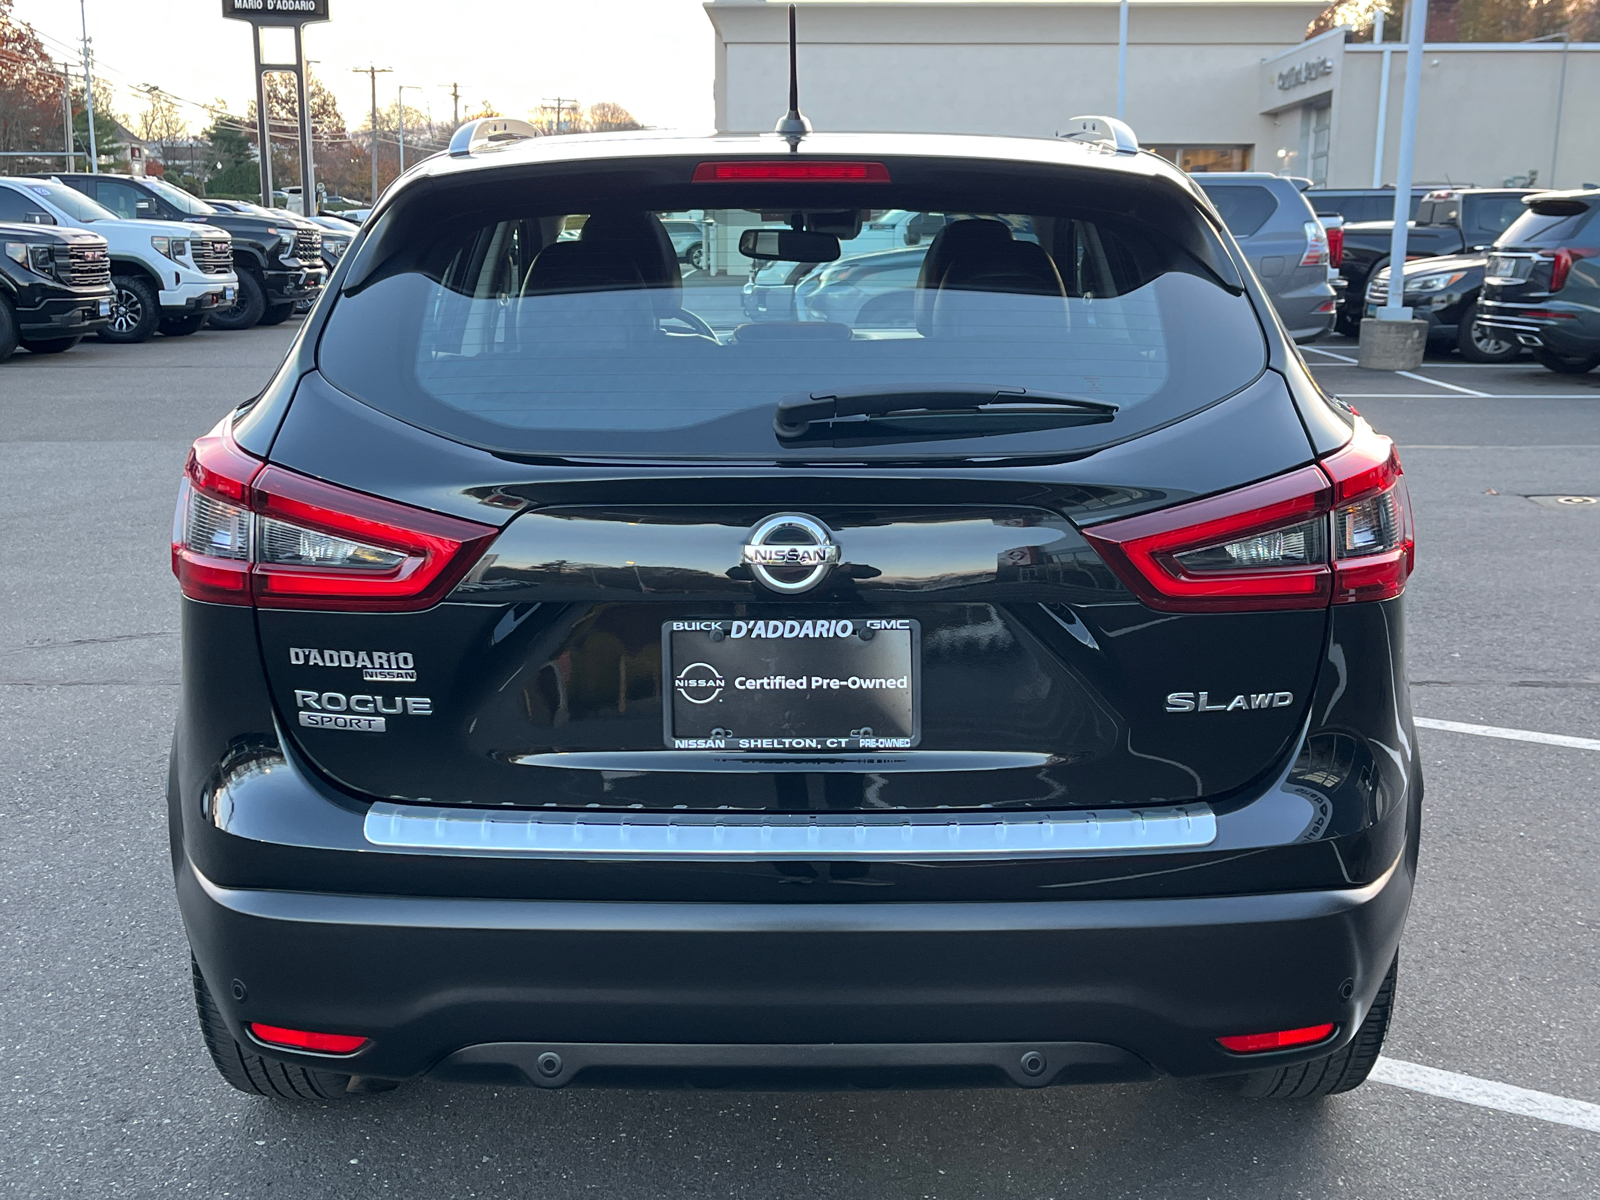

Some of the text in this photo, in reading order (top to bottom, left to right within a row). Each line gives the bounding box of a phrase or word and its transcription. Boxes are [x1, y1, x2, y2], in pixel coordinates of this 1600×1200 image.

[234, 0, 315, 11] MARIO D'ADDARIO
[754, 549, 827, 561] NISSAN
[672, 619, 910, 639] BUICK D'ADDARIO GMC
[289, 647, 415, 669] D'ADDARIO
[364, 670, 416, 680] NISSAN
[674, 679, 725, 687] NISSAN
[734, 675, 908, 690] Certified Pre-Owned
[294, 689, 433, 716] ROGUE
[307, 715, 377, 729] SPORT
[674, 738, 911, 749] NISSAN SHELTON, CT PRE-OWNED
